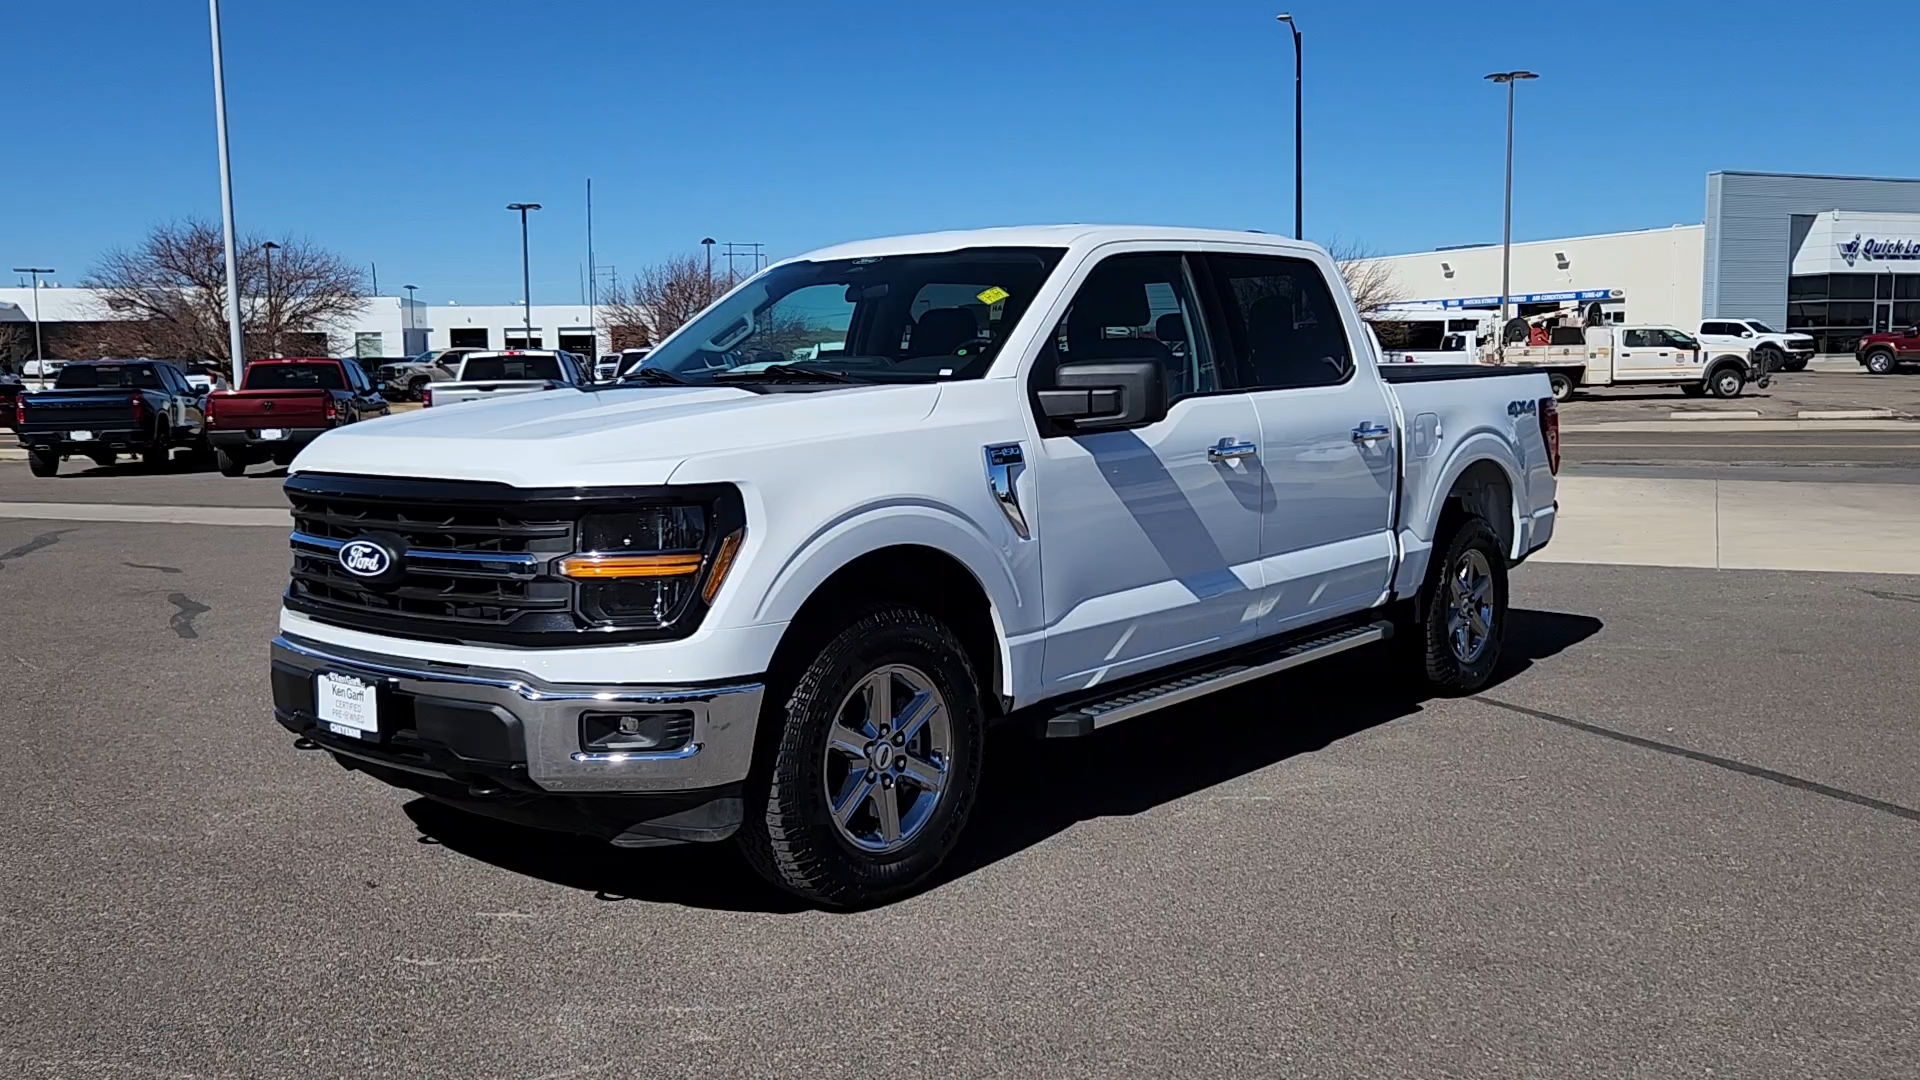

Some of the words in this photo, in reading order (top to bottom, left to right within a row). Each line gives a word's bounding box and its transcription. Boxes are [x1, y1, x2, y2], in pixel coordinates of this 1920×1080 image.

[1863, 238, 1904, 255] Quick
[1581, 291, 1604, 299] TUNE-UP
[990, 447, 1020, 457] F-150
[347, 545, 380, 571] Ford
[332, 684, 346, 698] Ken
[346, 687, 365, 702] Garff
[335, 700, 362, 713] CERTIFIED
[332, 708, 365, 724] PRE-OWNED
